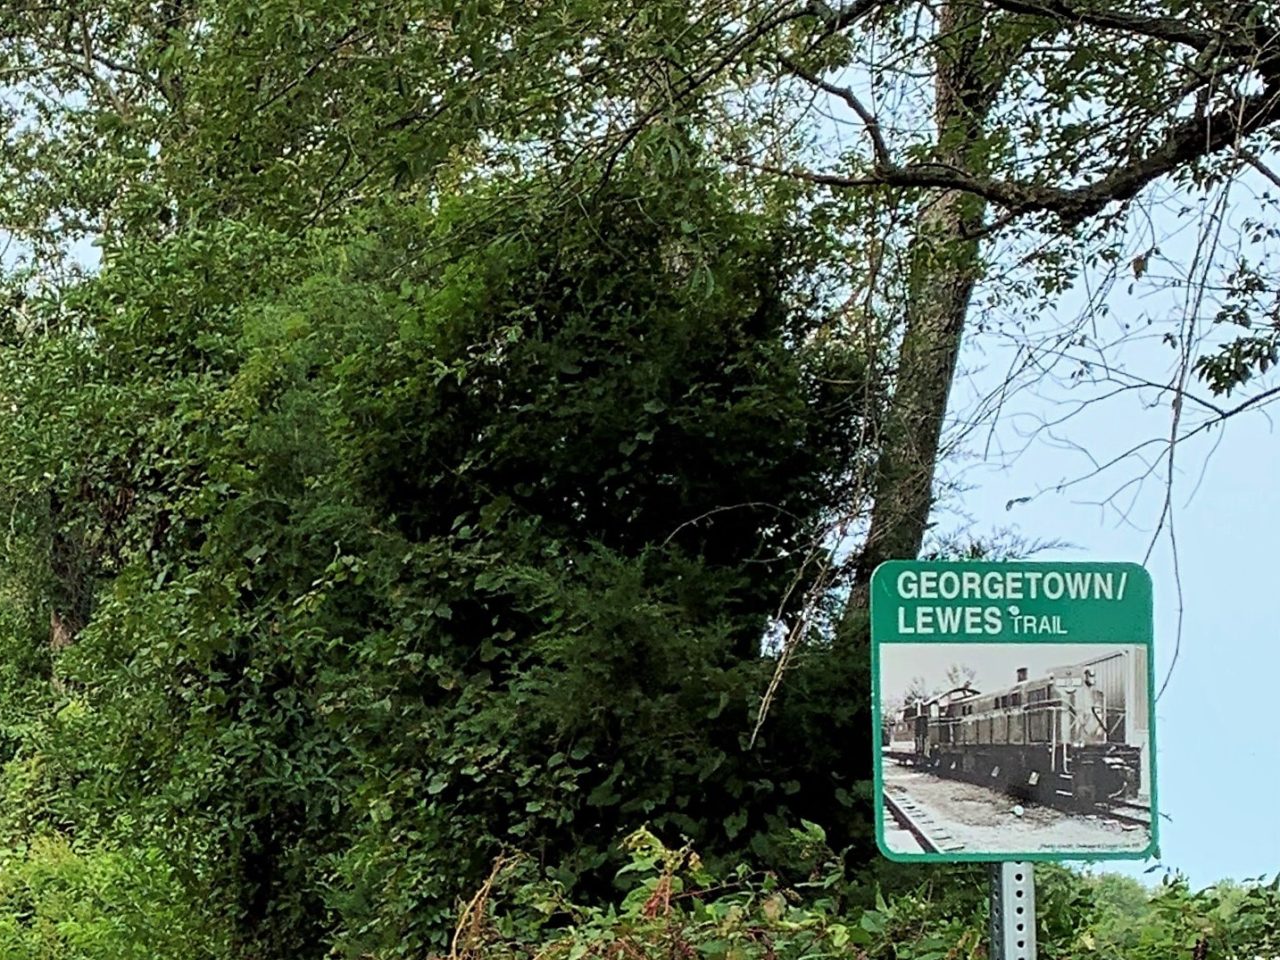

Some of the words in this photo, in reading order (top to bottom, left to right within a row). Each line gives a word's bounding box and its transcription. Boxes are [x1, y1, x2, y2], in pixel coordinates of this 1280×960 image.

[897, 570, 1128, 600] GEORGETOWN/
[898, 606, 1003, 635] LEWES
[1010, 614, 1068, 635] TRAIL
